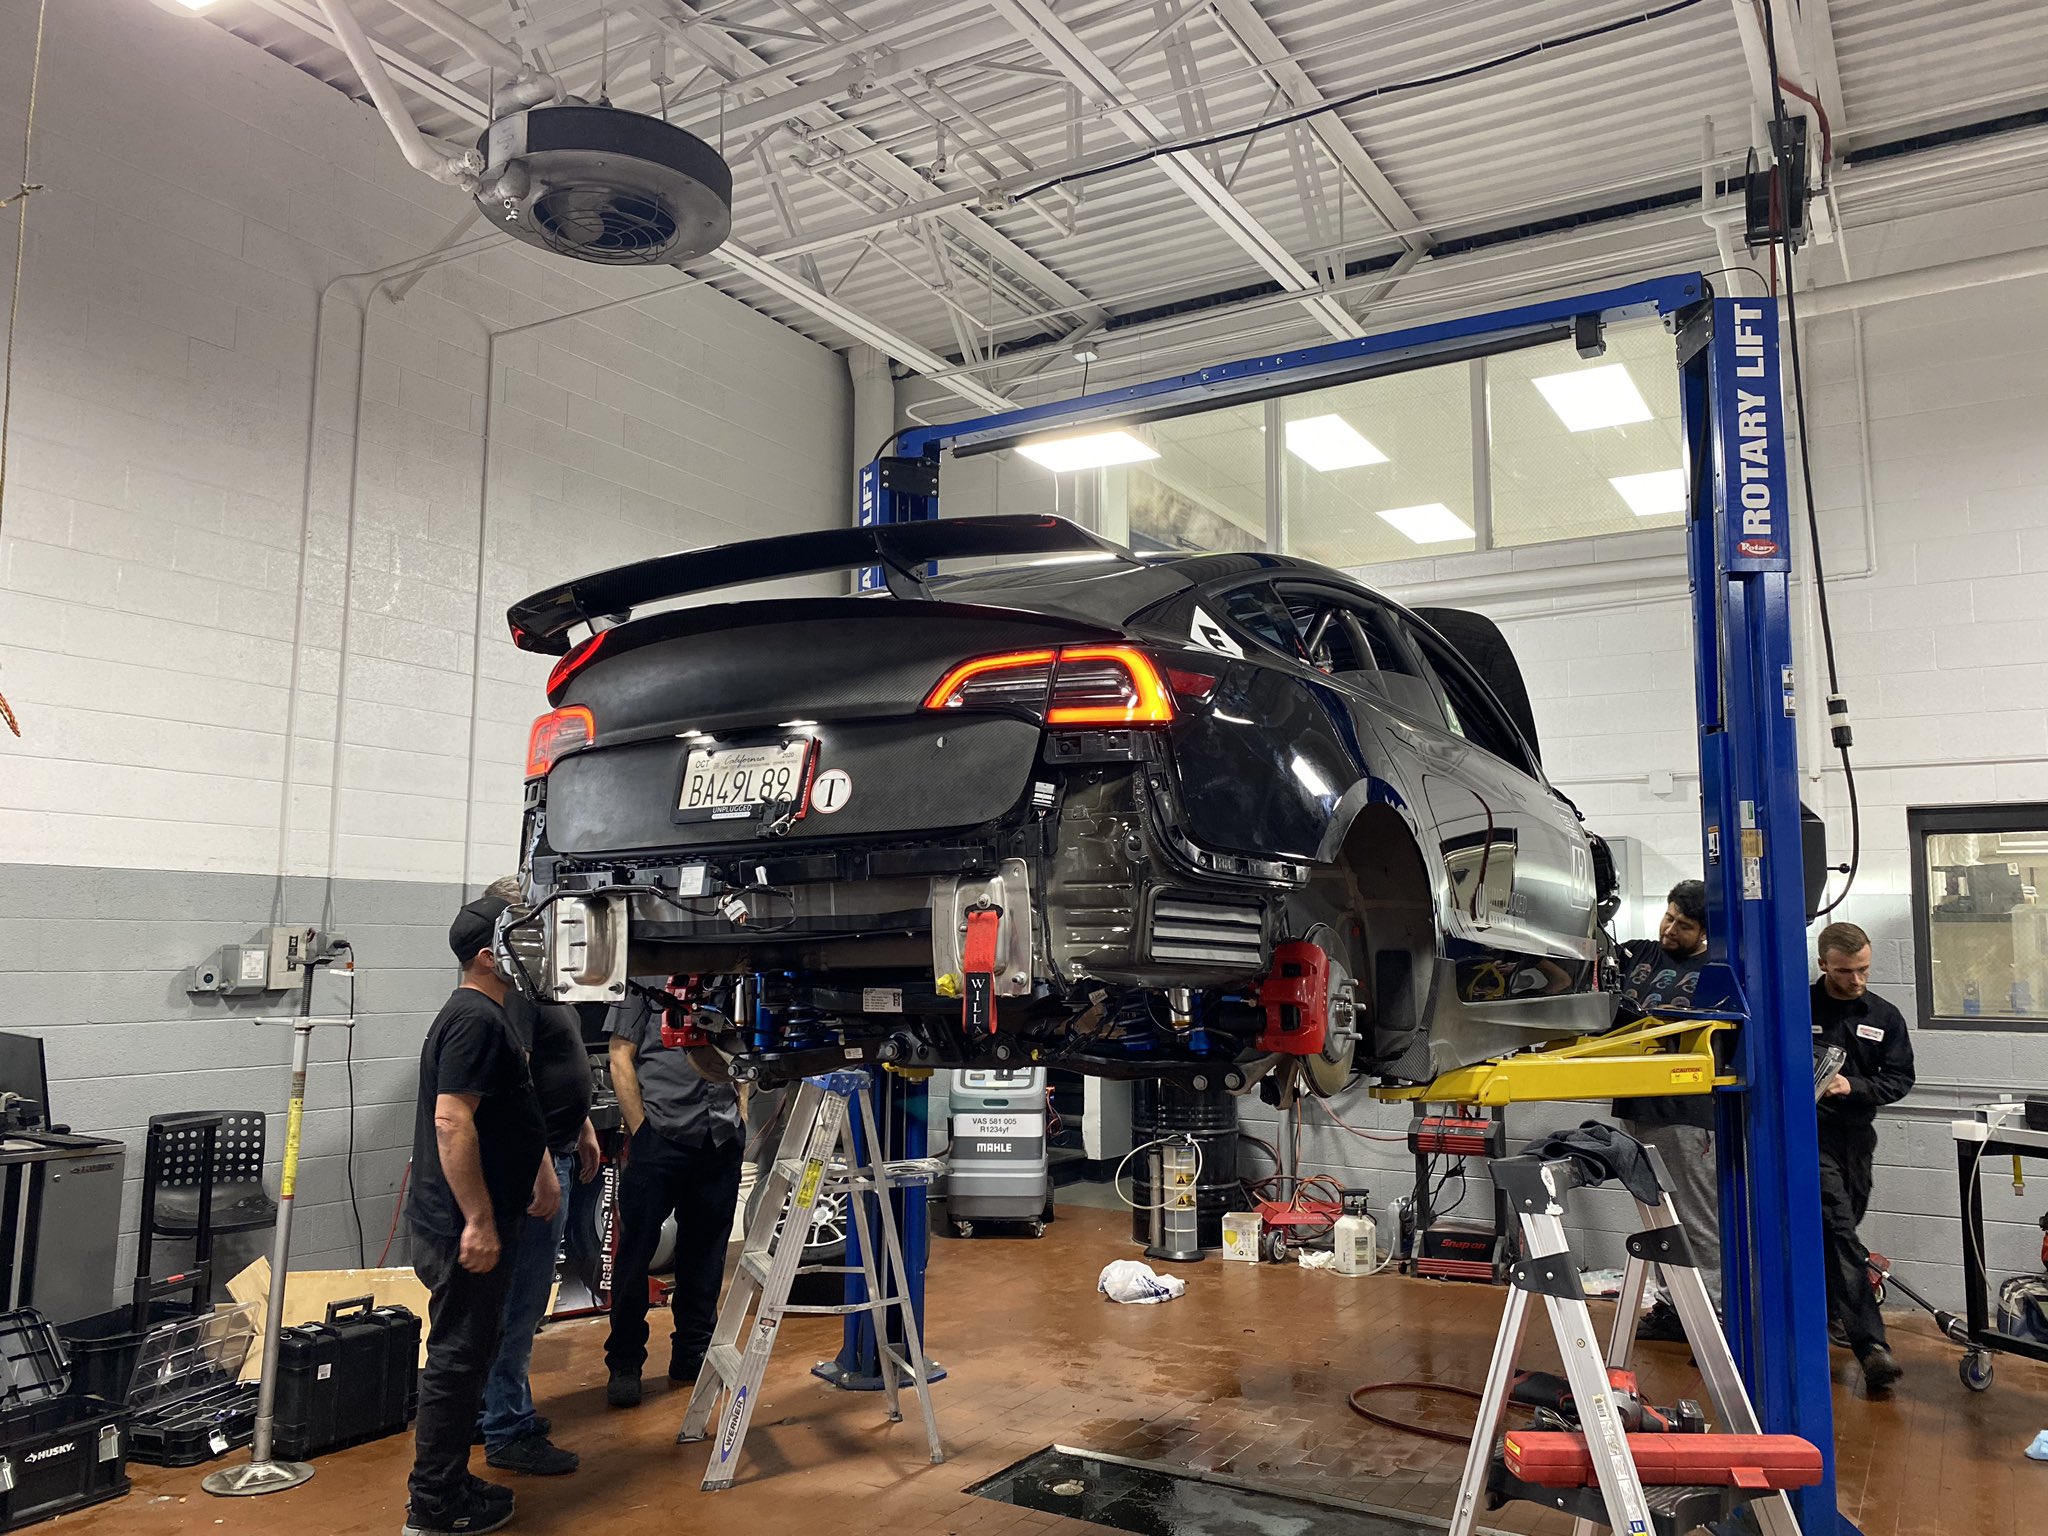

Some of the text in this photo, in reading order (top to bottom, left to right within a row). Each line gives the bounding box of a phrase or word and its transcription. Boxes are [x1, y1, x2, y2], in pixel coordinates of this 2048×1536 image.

[1734, 303, 1772, 535] ROTARY LIFT
[862, 471, 873, 527] LIFT
[1740, 541, 1776, 555] Rotary
[695, 759, 710, 769] OCT
[724, 754, 765, 769] California
[688, 767, 791, 807] BA49L89
[818, 777, 847, 808] T
[712, 804, 752, 814] UNPLUGGED
[971, 978, 986, 1034] WILLA
[972, 1117, 1017, 1125] VAS 581 005
[979, 1125, 1009, 1134] R1234yf
[976, 1143, 1012, 1152] MAHLE
[602, 1167, 614, 1209] Touch
[1440, 1238, 1488, 1249] Snap-on
[600, 1253, 613, 1291] Road
[725, 1400, 744, 1446] WERNER
